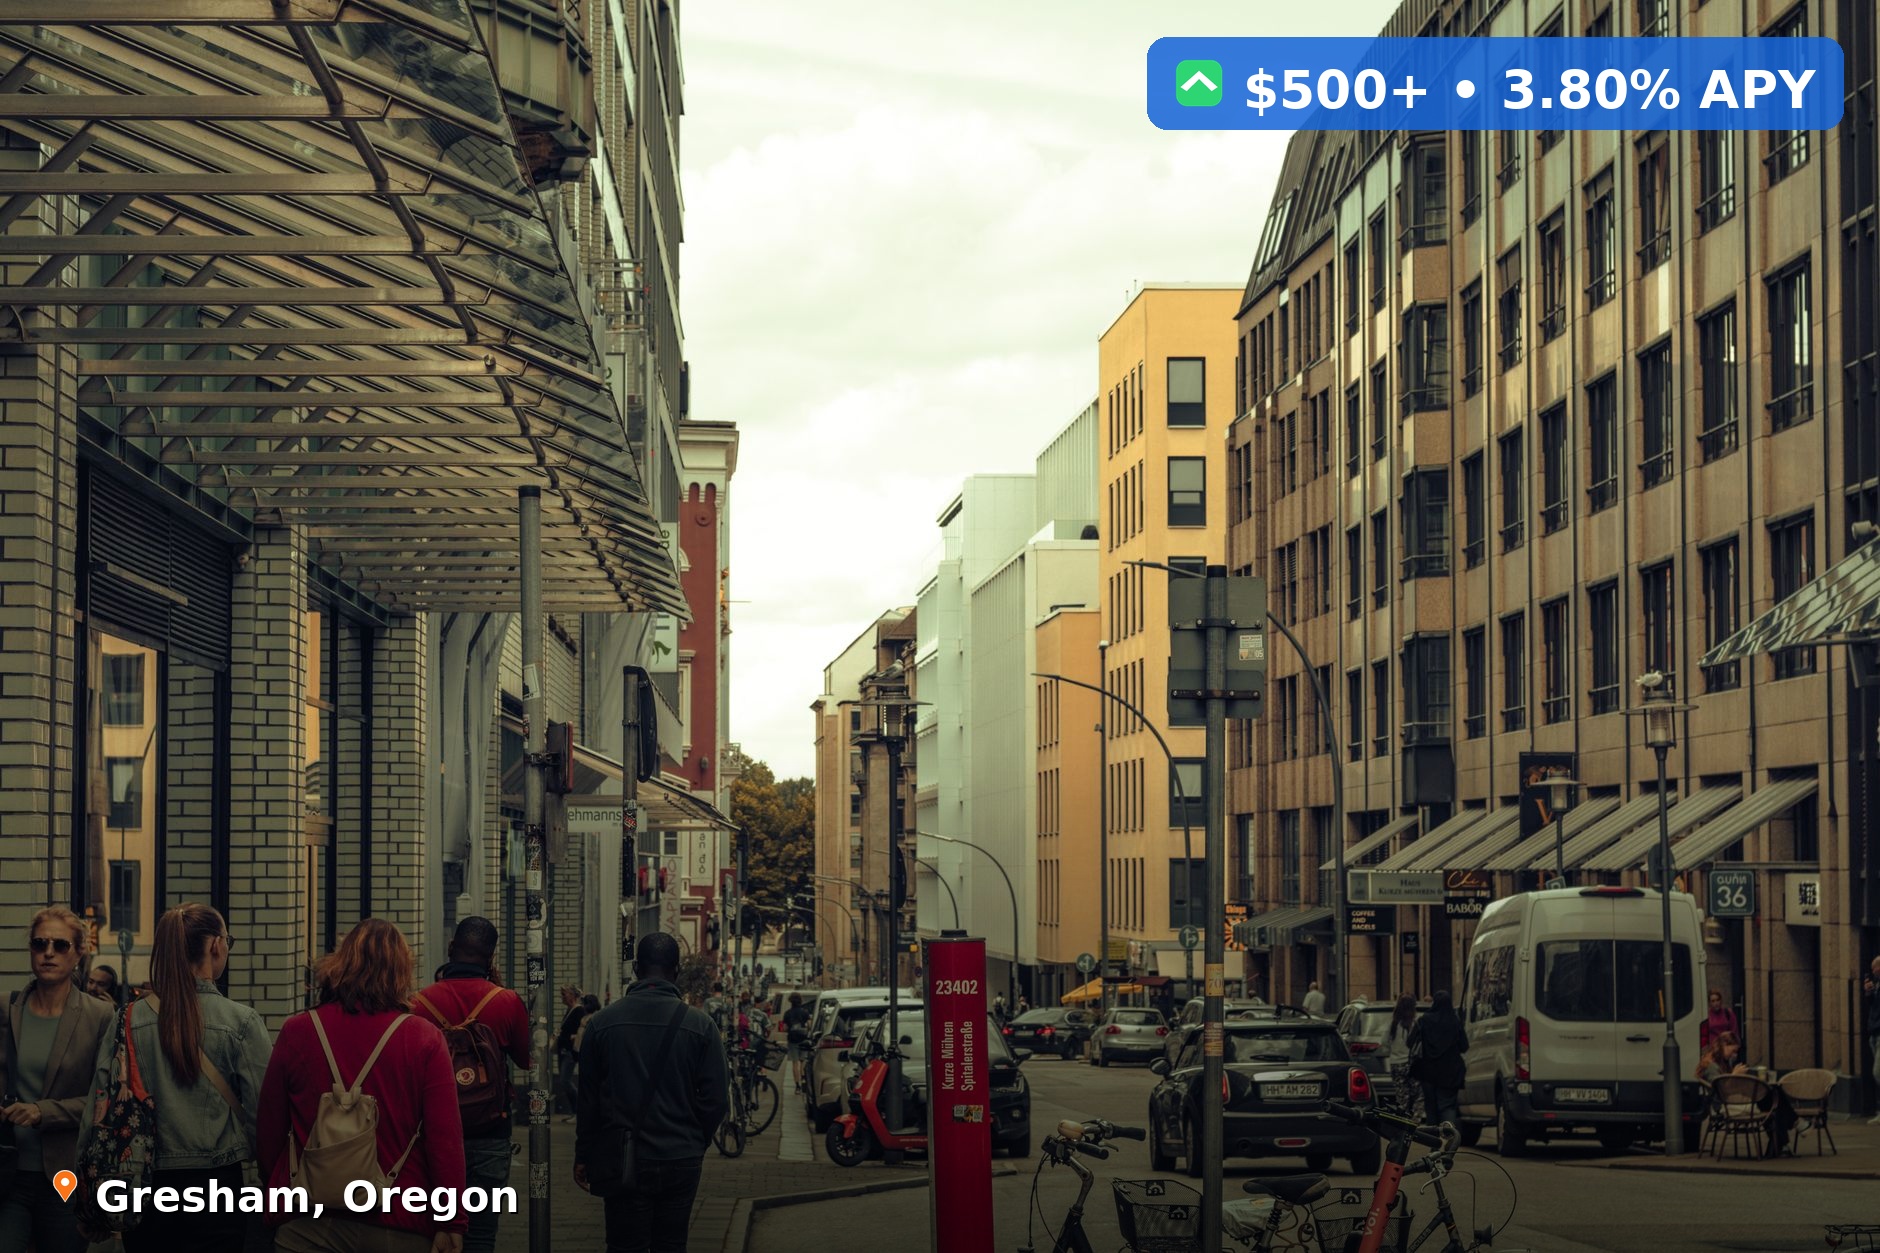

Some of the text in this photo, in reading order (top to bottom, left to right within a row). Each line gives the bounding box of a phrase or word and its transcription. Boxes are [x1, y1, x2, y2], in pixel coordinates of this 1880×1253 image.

[1717, 885, 1747, 908] 36
[935, 979, 978, 995] 23402
[941, 1021, 955, 1090] Kurze Mühren
[960, 1021, 974, 1091] Spitalerstraße
